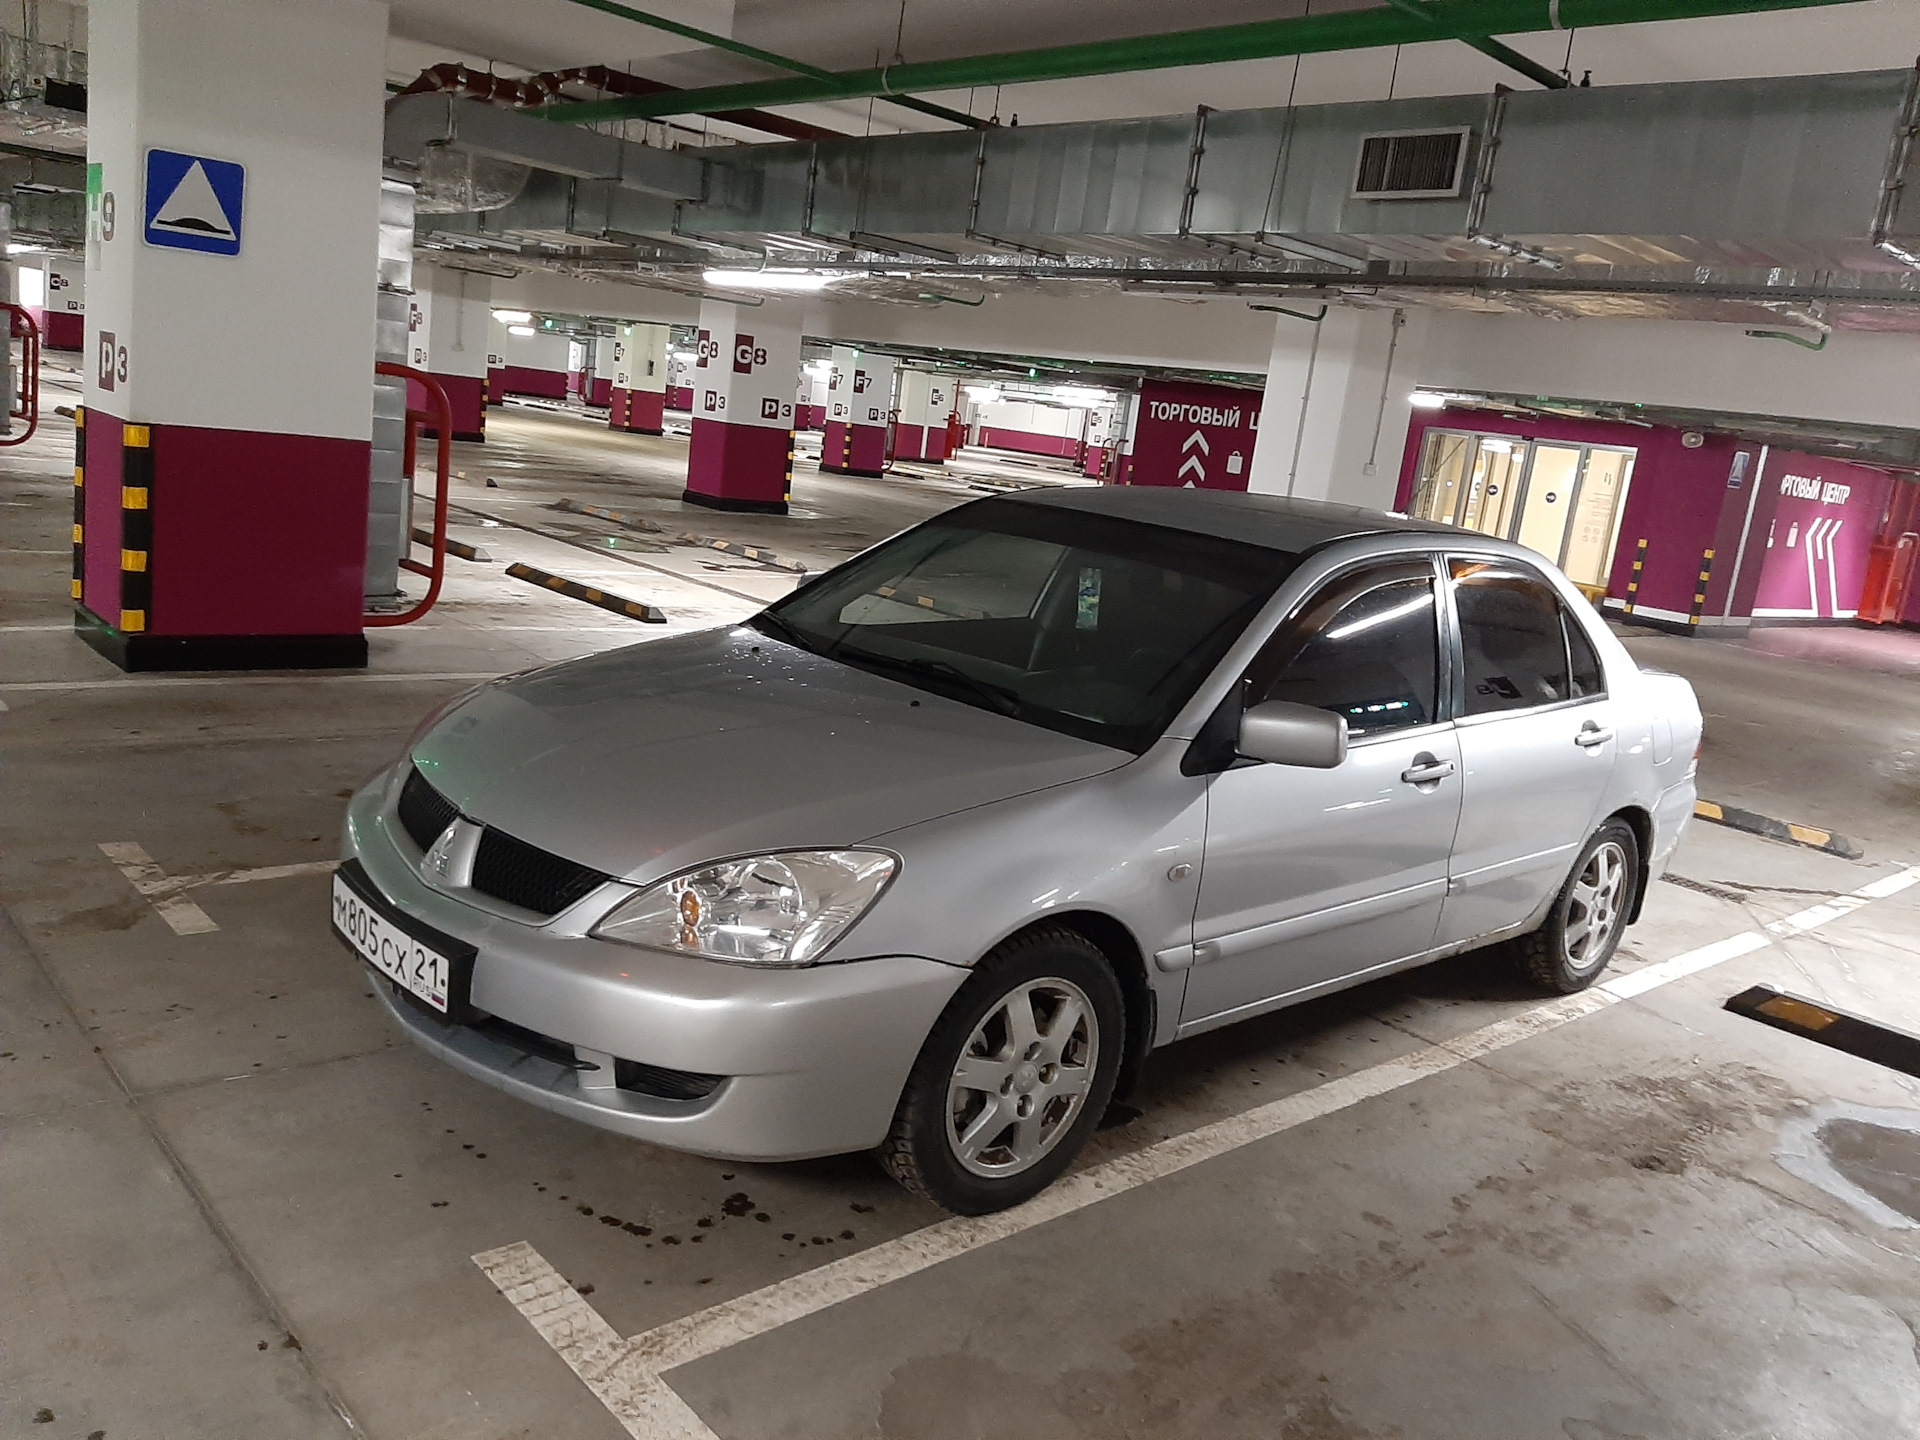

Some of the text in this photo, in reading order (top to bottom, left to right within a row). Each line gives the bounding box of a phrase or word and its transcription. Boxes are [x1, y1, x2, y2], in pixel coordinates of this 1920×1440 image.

[698, 340, 718, 358] G8
[736, 345, 767, 365] G8
[101, 341, 128, 383] P3
[830, 374, 843, 385] F7
[856, 377, 872, 388] F7
[707, 393, 726, 409] P3
[765, 401, 791, 417] P3
[1150, 401, 1240, 428] ТОРГОВЫЙ
[1821, 482, 1851, 505] ЦЕНТР
[415, 948, 438, 988] 21
